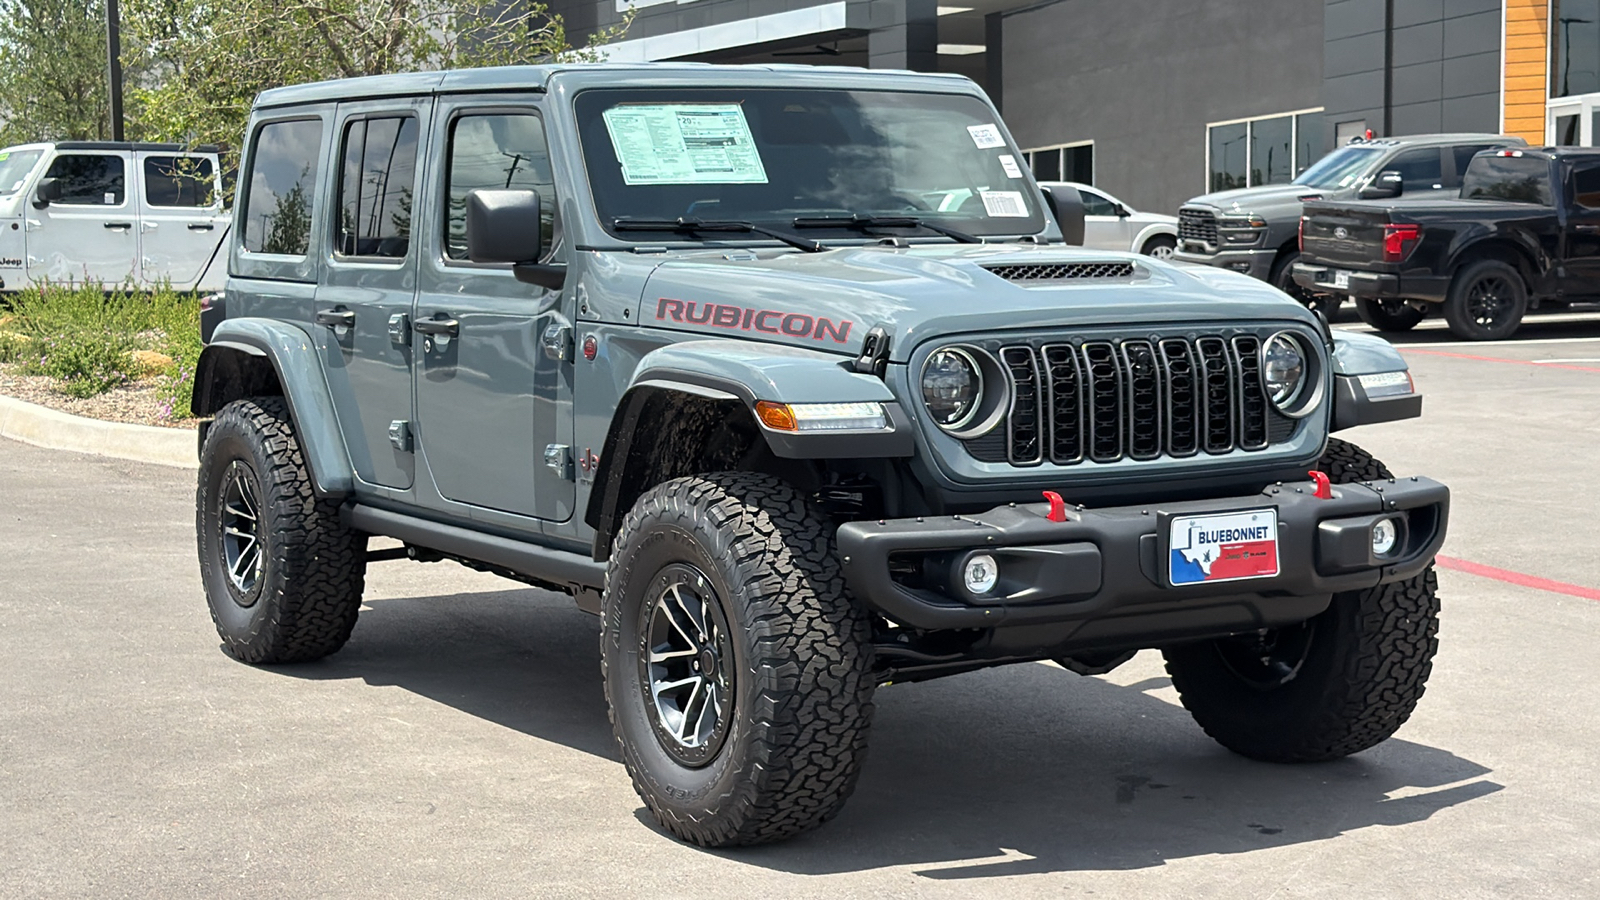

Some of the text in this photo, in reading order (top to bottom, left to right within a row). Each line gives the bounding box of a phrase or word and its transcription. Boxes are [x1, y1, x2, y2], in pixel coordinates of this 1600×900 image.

[682, 117, 692, 125] 20
[0, 257, 22, 266] Jeep
[655, 298, 854, 344] RUBICON
[579, 447, 600, 472] Je
[1198, 526, 1268, 544] BLUEBONNET
